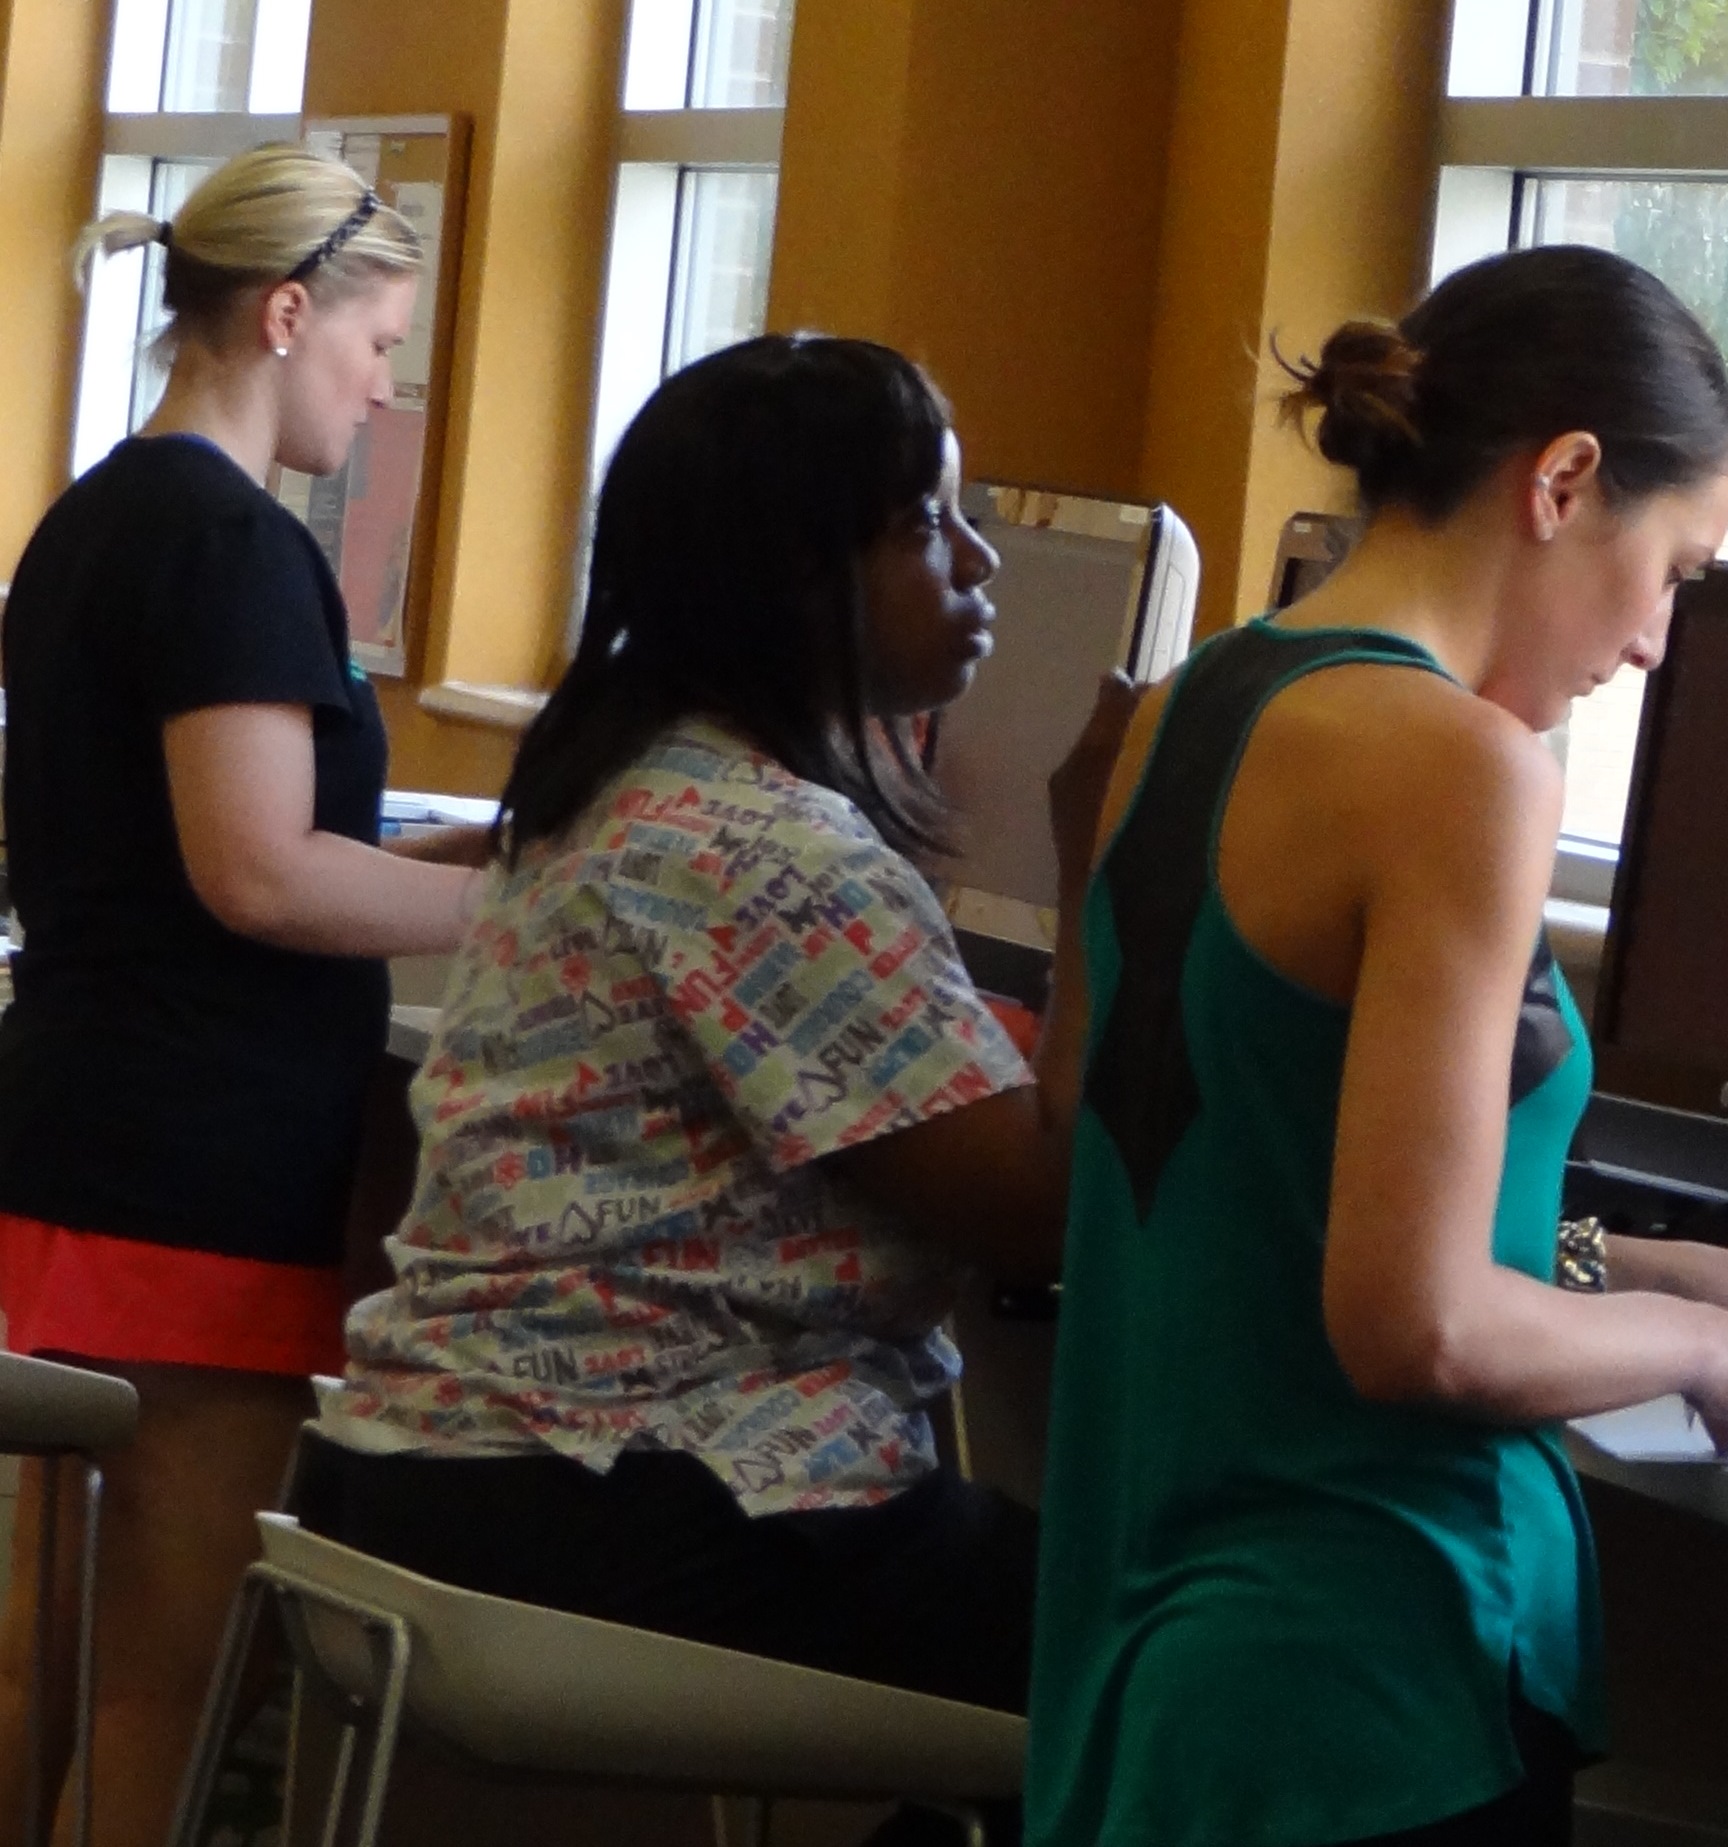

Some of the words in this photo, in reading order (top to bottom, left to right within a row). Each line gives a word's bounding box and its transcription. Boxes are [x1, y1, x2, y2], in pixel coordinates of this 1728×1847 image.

[818, 1015, 885, 1068] FUN
[598, 1196, 661, 1228] FUN
[513, 1344, 578, 1386] FUN
